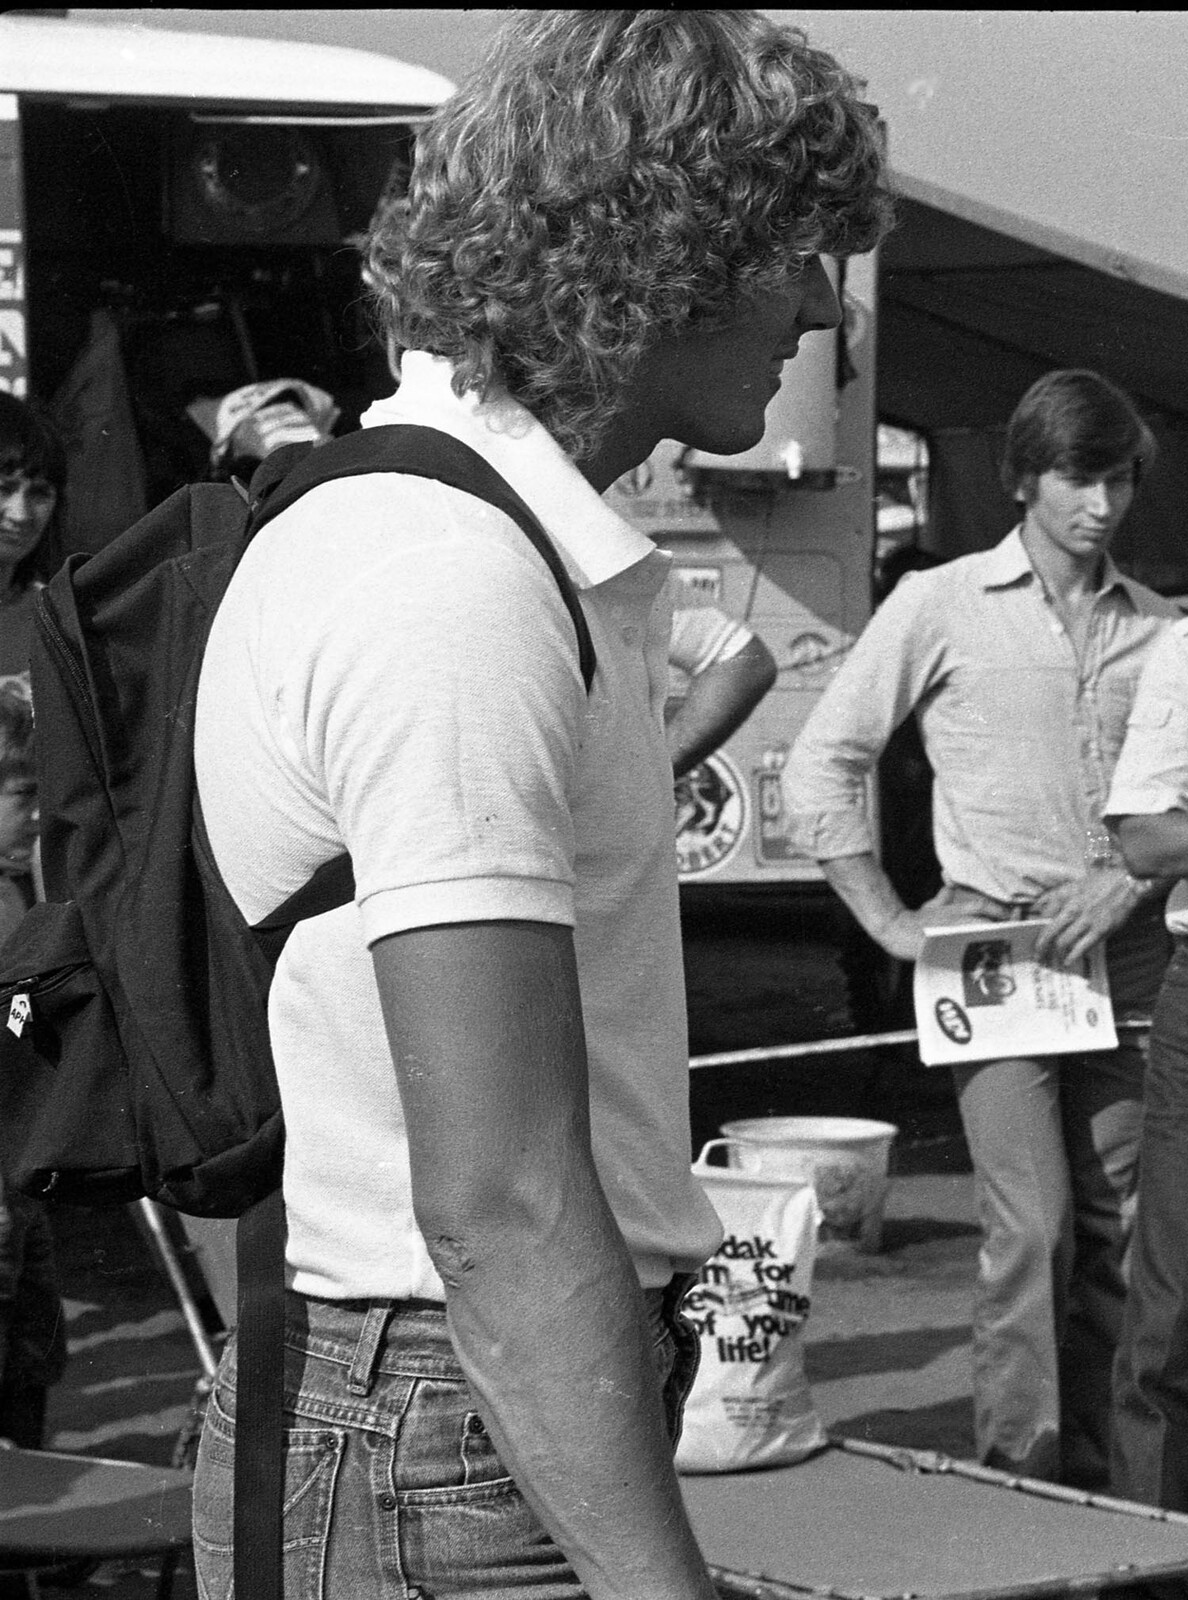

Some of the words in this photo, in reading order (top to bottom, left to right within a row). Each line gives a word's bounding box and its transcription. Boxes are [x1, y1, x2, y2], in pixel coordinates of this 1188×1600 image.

[715, 1235, 778, 1260] dak
[753, 1262, 796, 1284] for
[717, 1336, 770, 1364] life!
